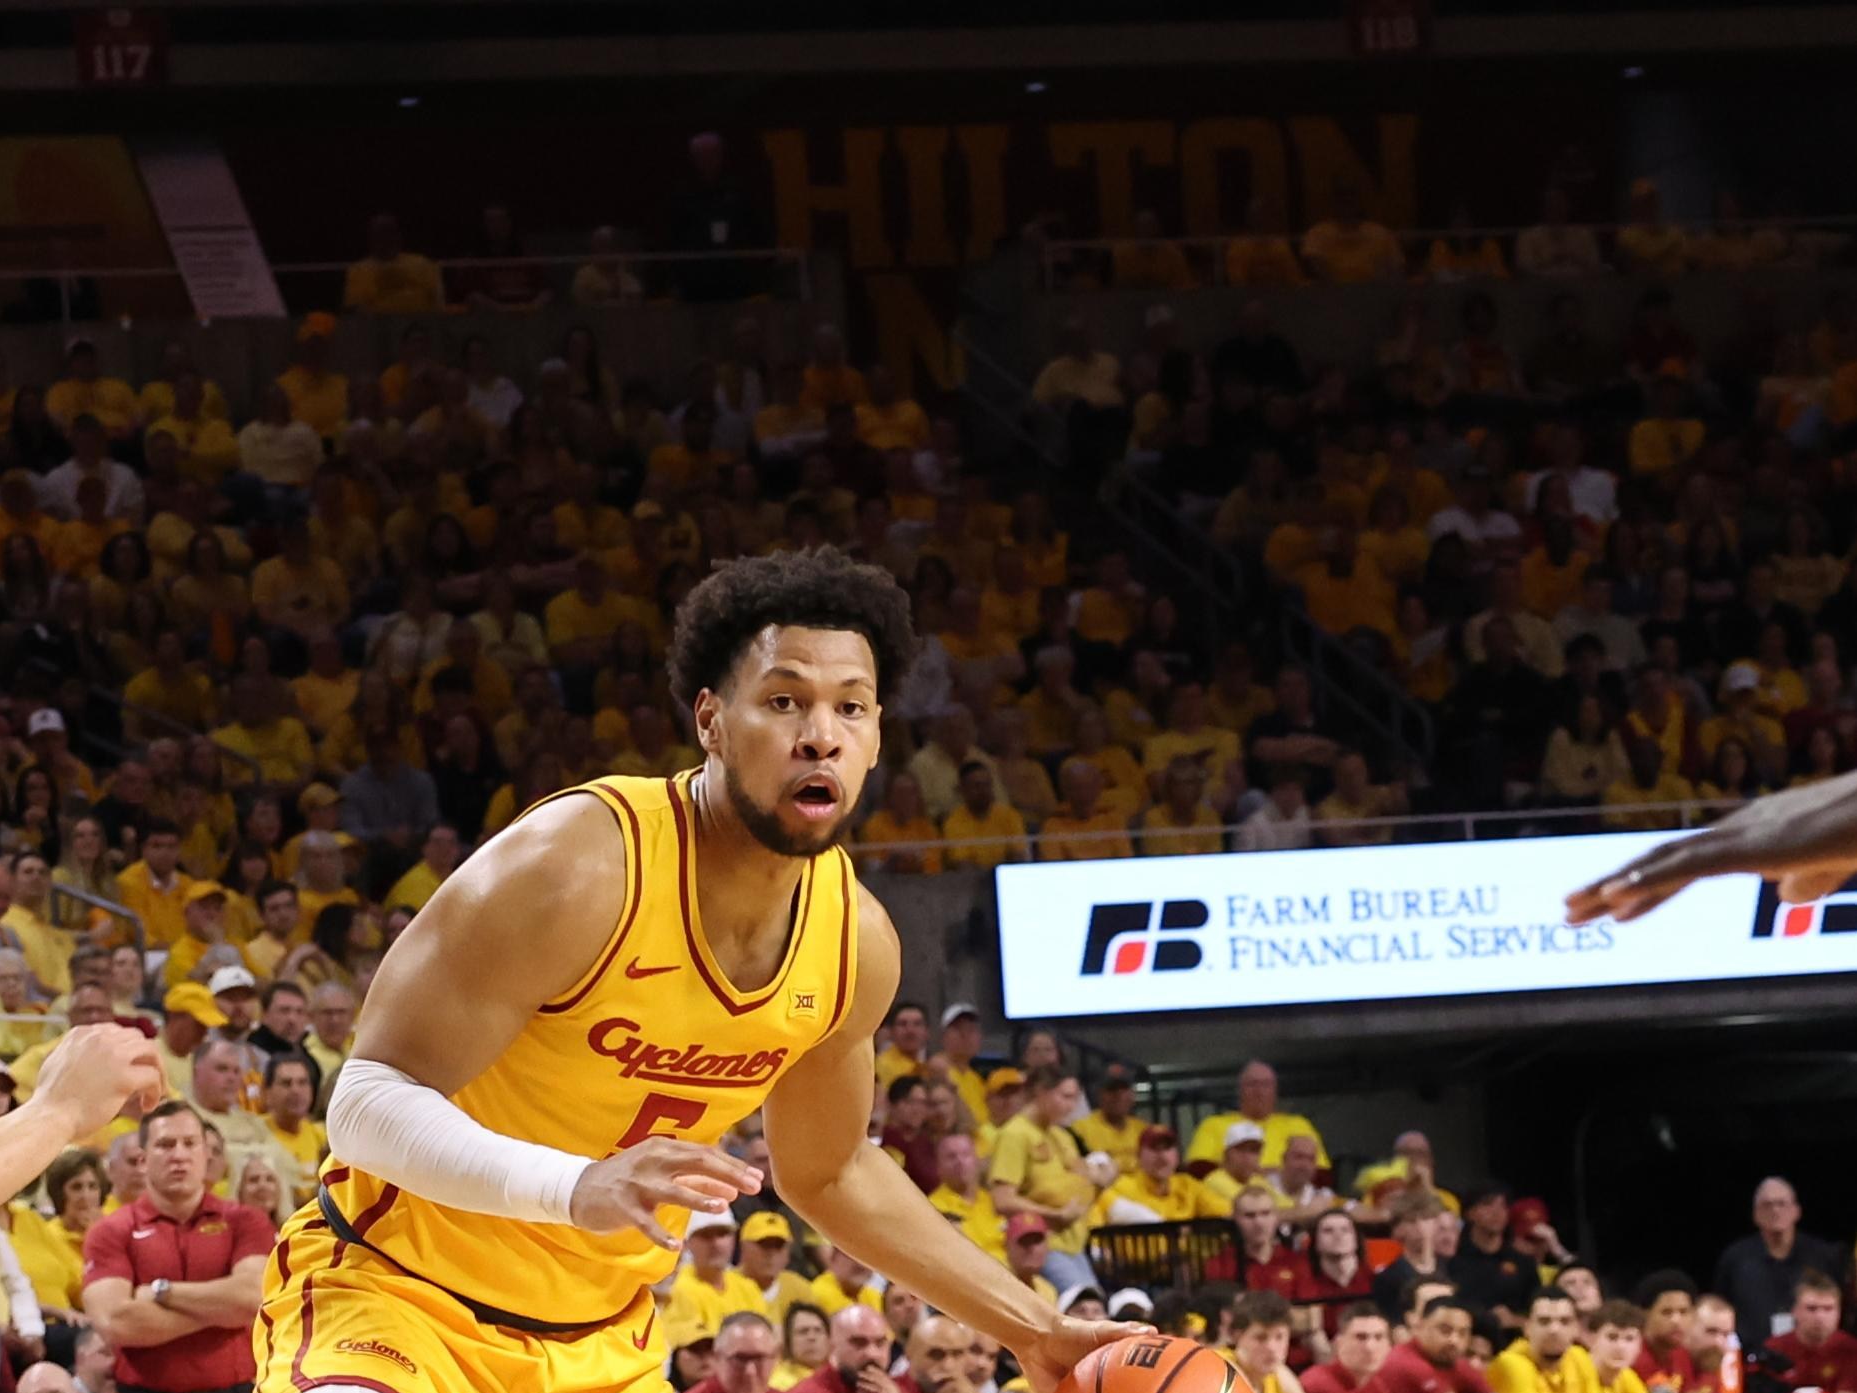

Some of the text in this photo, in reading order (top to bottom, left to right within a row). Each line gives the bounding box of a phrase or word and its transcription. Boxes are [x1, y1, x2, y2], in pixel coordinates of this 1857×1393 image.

[90, 43, 153, 80] 117
[1225, 885, 1501, 928] FARM BUREAU
[1228, 920, 1615, 973] FINANCIAL SERVICES
[794, 993, 815, 1009] XII
[587, 1016, 789, 1088] Cyclones
[334, 1338, 418, 1375] Cyclones
